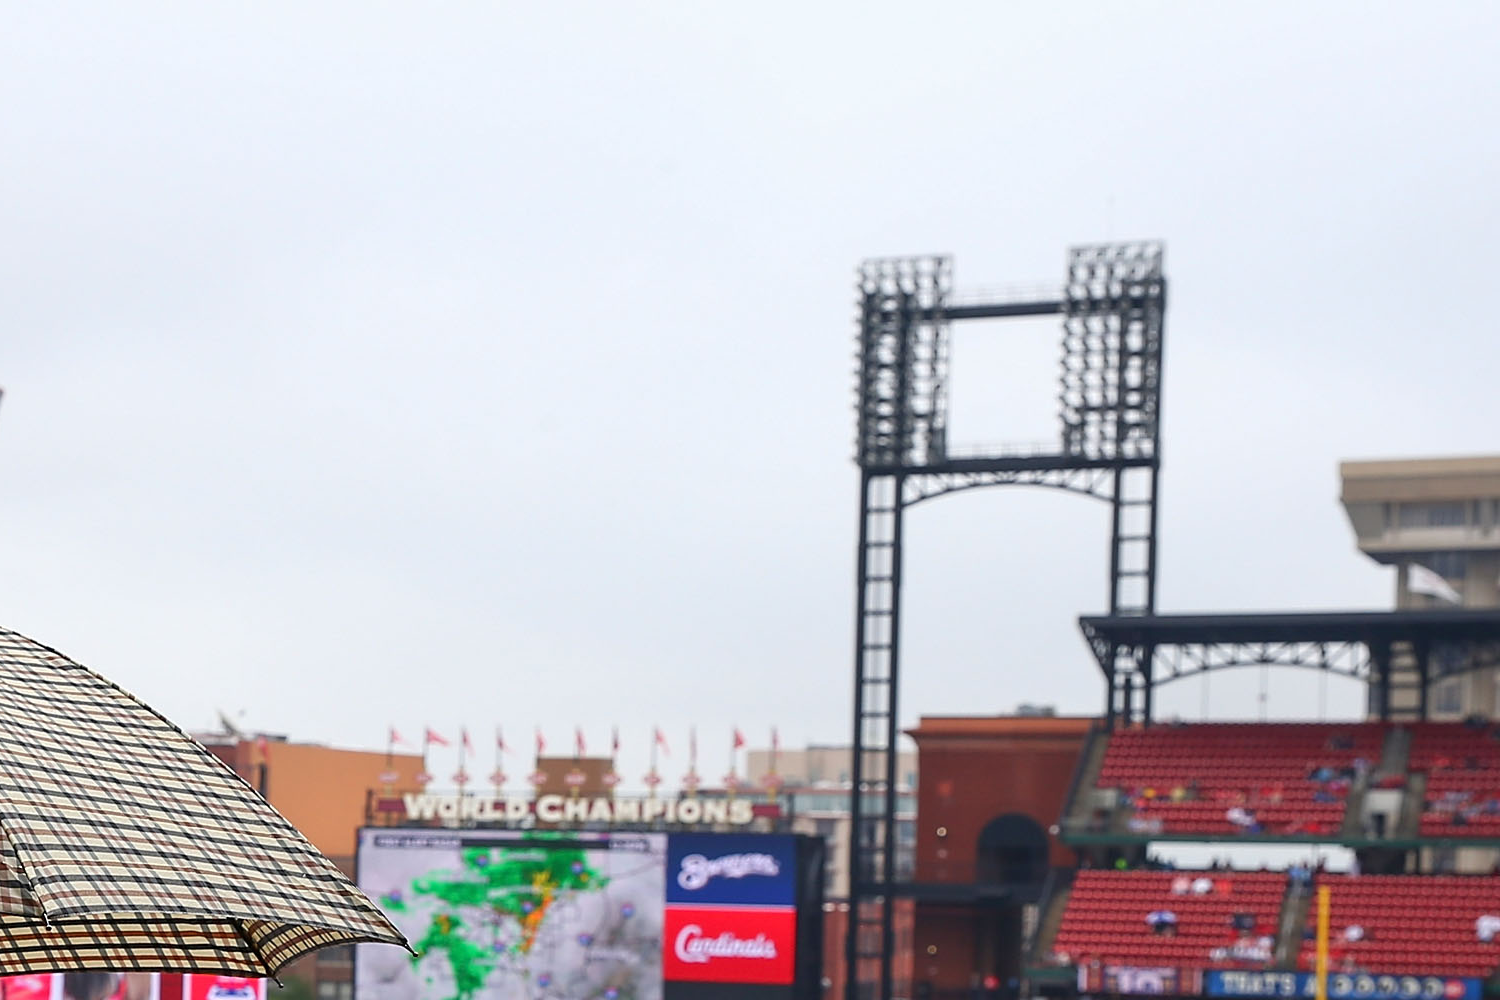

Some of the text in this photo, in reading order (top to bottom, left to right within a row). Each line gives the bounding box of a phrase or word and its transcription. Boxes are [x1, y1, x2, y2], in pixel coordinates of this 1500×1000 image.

[404, 793, 755, 825] WORLD CHAMPIONS
[674, 923, 779, 964] Cardinals
